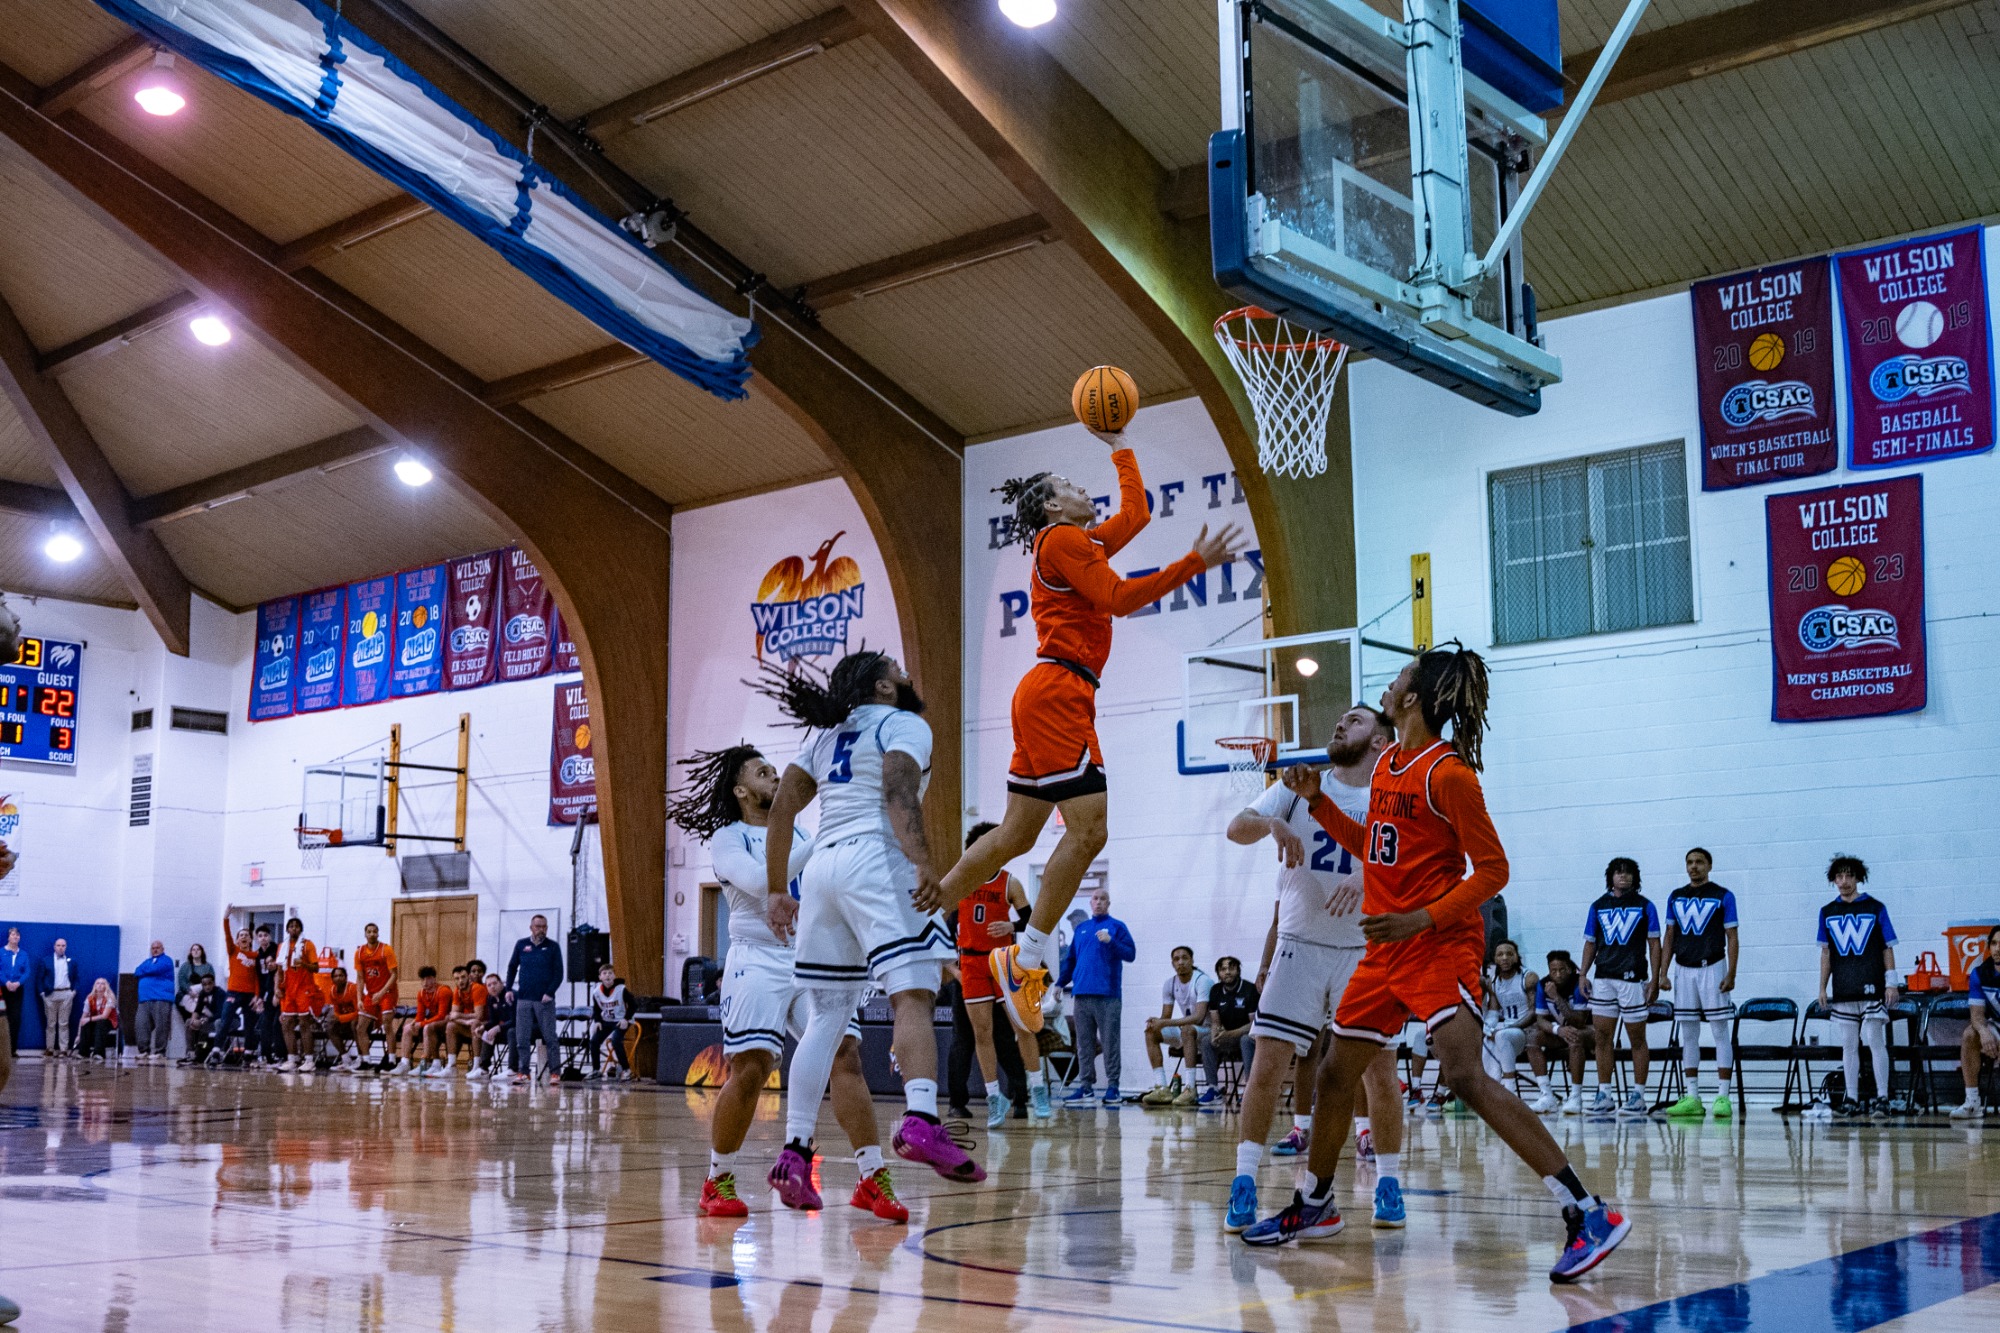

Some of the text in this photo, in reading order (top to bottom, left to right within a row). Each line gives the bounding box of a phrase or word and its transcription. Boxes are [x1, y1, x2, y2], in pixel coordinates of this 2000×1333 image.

[1863, 242, 1955, 283] WILSON
[1718, 271, 1802, 311] WILSON
[1878, 273, 1947, 304] COLLEGE
[1731, 300, 1794, 331] COLLEGE
[1861, 300, 1971, 345] 20 19
[1714, 327, 1816, 371] 20 19
[1903, 362, 1967, 385] CSAC
[1108, 393, 1120, 423] NCAA
[1751, 387, 1812, 410] CSAC
[1881, 404, 1962, 434] BASEBALL
[1710, 427, 1831, 460] WOMEN'S BASKETBALL
[1872, 427, 1974, 459] SEMI-FINALS
[1736, 452, 1805, 476] FINAL FOUR
[1798, 493, 1889, 529] WILSON
[1812, 523, 1879, 551] COLLEGE
[456, 558, 491, 580] WILSON
[1788, 553, 1904, 592] 20 23
[399, 610, 412, 627] 20
[429, 604, 440, 621] 18
[752, 585, 863, 634] WILSON
[303, 625, 340, 645] 20 17
[350, 619, 361, 634] 20
[464, 631, 489, 645] CSAC
[520, 619, 544, 633] CSAC
[766, 620, 847, 652] COLLEGE
[1832, 615, 1895, 637] CSAC
[285, 634, 295, 650] 17
[37, 671, 74, 688] GUEST
[1787, 663, 1912, 685] MEN'S BASKETBALL
[41, 687, 75, 717] 22
[566, 687, 588, 706] WIL
[1811, 682, 1895, 701] CHAMPIONS
[7, 712, 27, 723] FOUL
[50, 717, 75, 729] FOULS
[58, 728, 71, 749] 3
[48, 751, 74, 761] SCORE
[828, 731, 863, 784] 5
[574, 762, 595, 775] CSA
[1310, 829, 1353, 875] 21
[1368, 820, 1399, 867] 13
[973, 903, 986, 924] 0
[1672, 897, 1722, 935] W
[1598, 907, 1643, 945] W
[1826, 914, 1877, 956] W
[1962, 938, 1980, 957] G
[1506, 1005, 1519, 1019] 11
